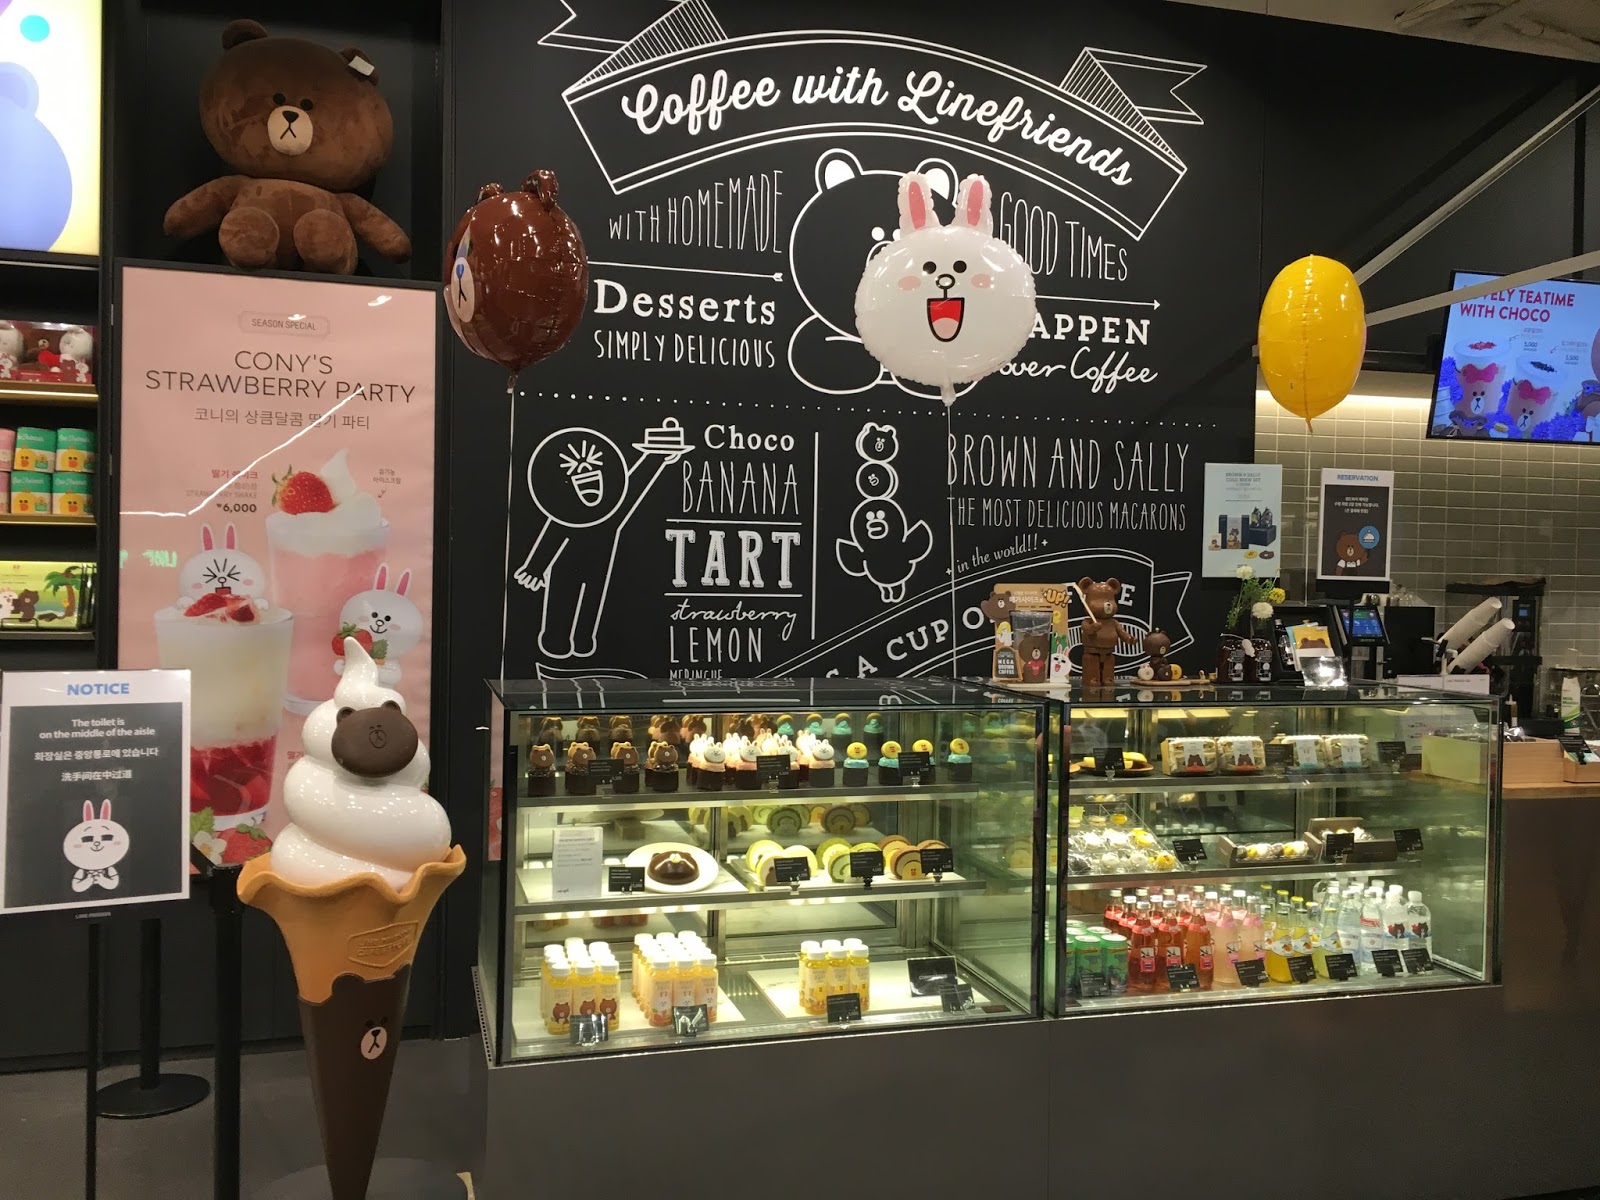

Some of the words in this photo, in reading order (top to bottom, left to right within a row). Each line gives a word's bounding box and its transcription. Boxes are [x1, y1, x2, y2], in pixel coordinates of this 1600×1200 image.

[621, 69, 781, 135] Coffee
[792, 66, 888, 106] with
[897, 70, 1133, 186] Linefriends
[609, 204, 660, 243] WITH
[667, 170, 783, 254] HOMEMADE
[1000, 191, 1059, 276] GOOD
[1065, 220, 1128, 282] TIMES
[593, 278, 776, 325] Desserts
[1460, 302, 1495, 319] WITH
[1499, 305, 1551, 323] CHOCO
[1519, 289, 1576, 307] TEATIME
[251, 318, 284, 329] SEASON
[285, 320, 317, 331] SPECIAL
[1028, 312, 1151, 346] APPEN
[234, 350, 333, 375] CONY'S
[593, 329, 666, 362] SIMPLY
[674, 332, 776, 369] DELICIOUS
[145, 369, 327, 399] STRAWBERRY
[336, 381, 416, 403] PARTY
[1000, 360, 1067, 378] over
[1070, 346, 1159, 394] Coffee
[194, 407, 239, 424] 코니의
[244, 409, 304, 427] 상큼달콤
[308, 413, 338, 429] 딸기
[342, 415, 370, 430] 파티
[704, 424, 795, 452] Choco
[947, 433, 1037, 488] BROWN
[1048, 437, 1101, 490] AND
[1113, 440, 1189, 493] SALLY
[1336, 474, 1379, 482] RESERVATION
[682, 460, 800, 515] BANANA
[947, 497, 976, 527] THE
[982, 498, 1022, 528] MOST
[1028, 499, 1104, 529] DELICIOUS
[1109, 502, 1187, 532] MACARONS
[665, 528, 801, 589] TART
[957, 559, 970, 574] in
[971, 546, 991, 567] the
[993, 533, 1038, 561] world!!
[669, 598, 797, 642] strawberry
[669, 625, 762, 663] LEMON
[856, 655, 879, 678] A
[886, 618, 950, 661] CUP
[66, 683, 130, 696] NOTICE
[38, 730, 53, 739] on
[53, 729, 71, 739] the
[71, 728, 105, 738] middle
[105, 727, 117, 737] of
[117, 727, 133, 737] the
[133, 726, 156, 736] aisle
[71, 719, 90, 728] The
[91, 717, 116, 727] toilet
[117, 717, 125, 726] is
[34, 750, 73, 762] 화장실은
[121, 747, 159, 758] 있습니다
